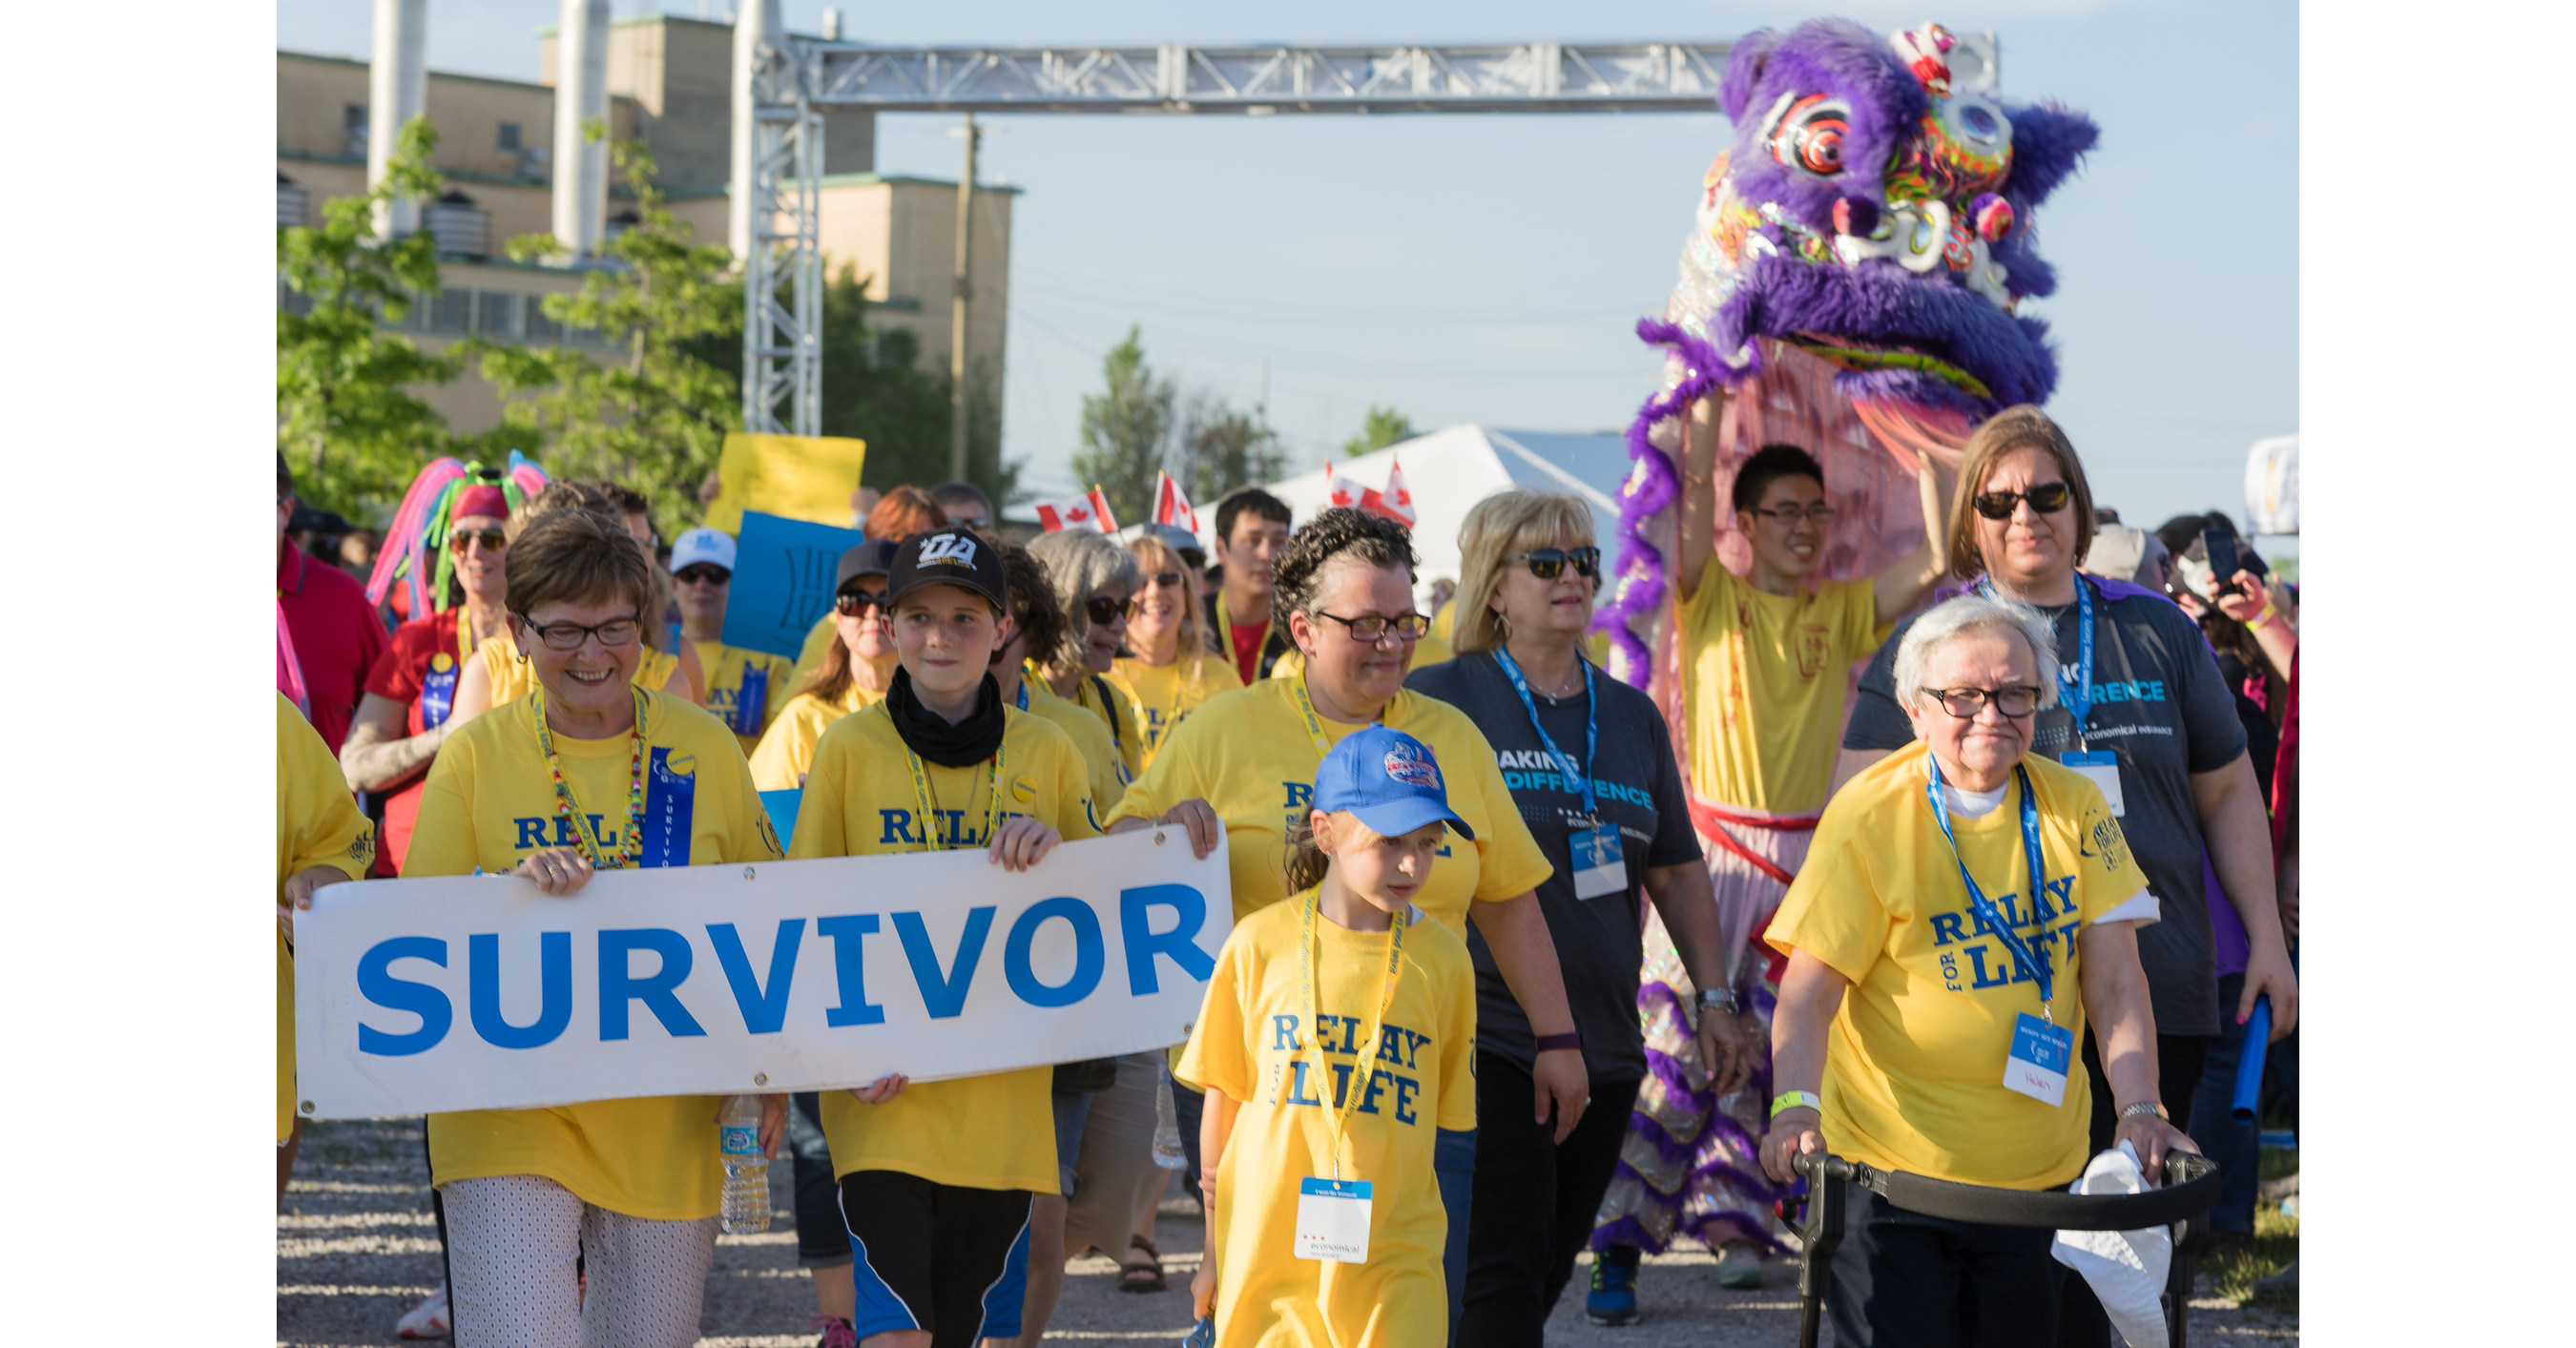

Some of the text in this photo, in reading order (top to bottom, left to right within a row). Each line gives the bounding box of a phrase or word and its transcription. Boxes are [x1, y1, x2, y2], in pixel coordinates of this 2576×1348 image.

[1504, 771, 1654, 811] DIFFEENCE
[661, 794, 674, 868] SURVIVO
[357, 883, 1217, 1057] SURVIVOR
[1940, 950, 1963, 993] FOR
[1273, 1014, 1431, 1070] RELAY
[1286, 1060, 1421, 1127] LIFE
